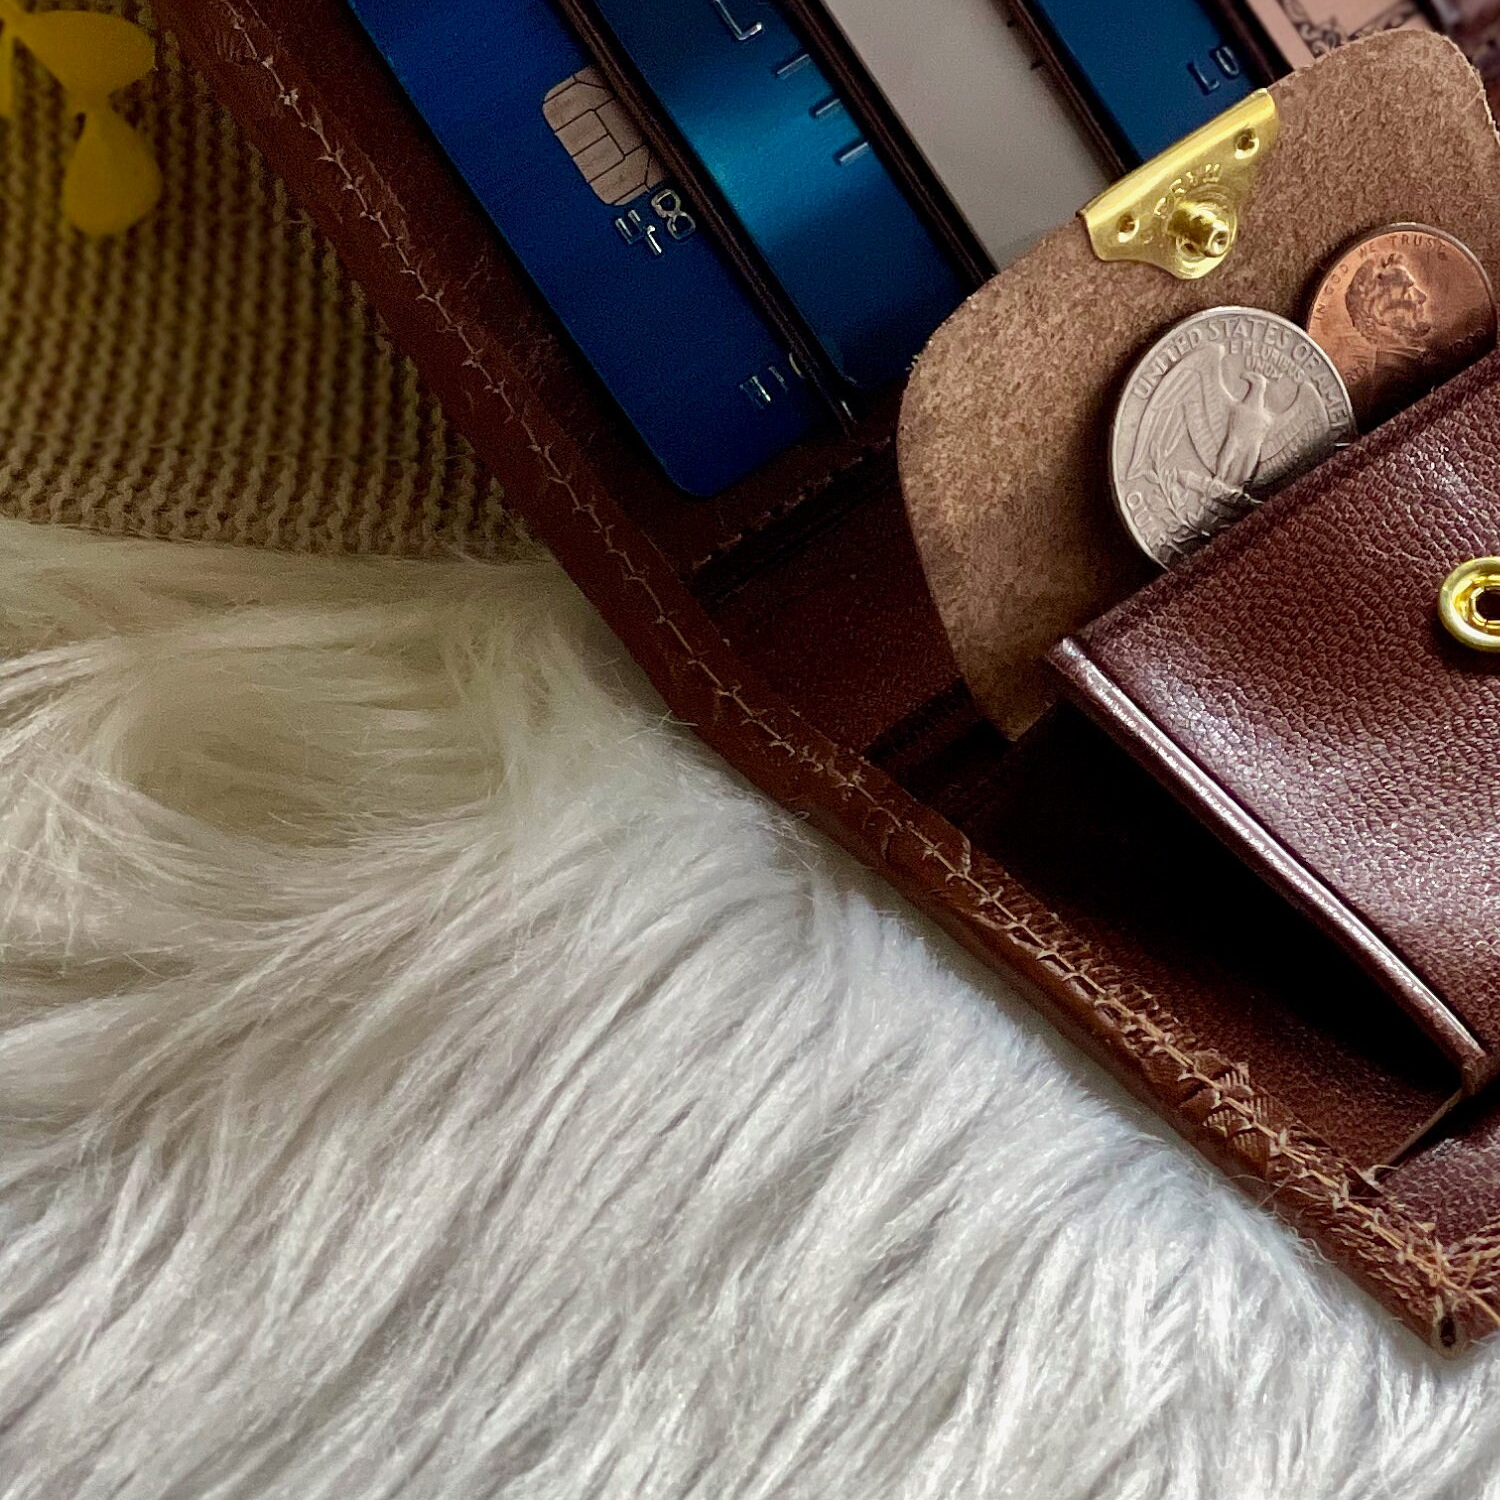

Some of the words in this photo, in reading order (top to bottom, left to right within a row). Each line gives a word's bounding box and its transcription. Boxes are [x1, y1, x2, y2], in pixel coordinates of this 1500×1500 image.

[614, 188, 697, 256] 48
[1323, 263, 1350, 298] GOD
[1357, 242, 1377, 260] WE
[1388, 234, 1448, 253] TRUST
[1132, 326, 1202, 400] UNITED
[1206, 316, 1293, 350] STATES
[1291, 339, 1323, 369] OF
[1231, 339, 1240, 354] E
